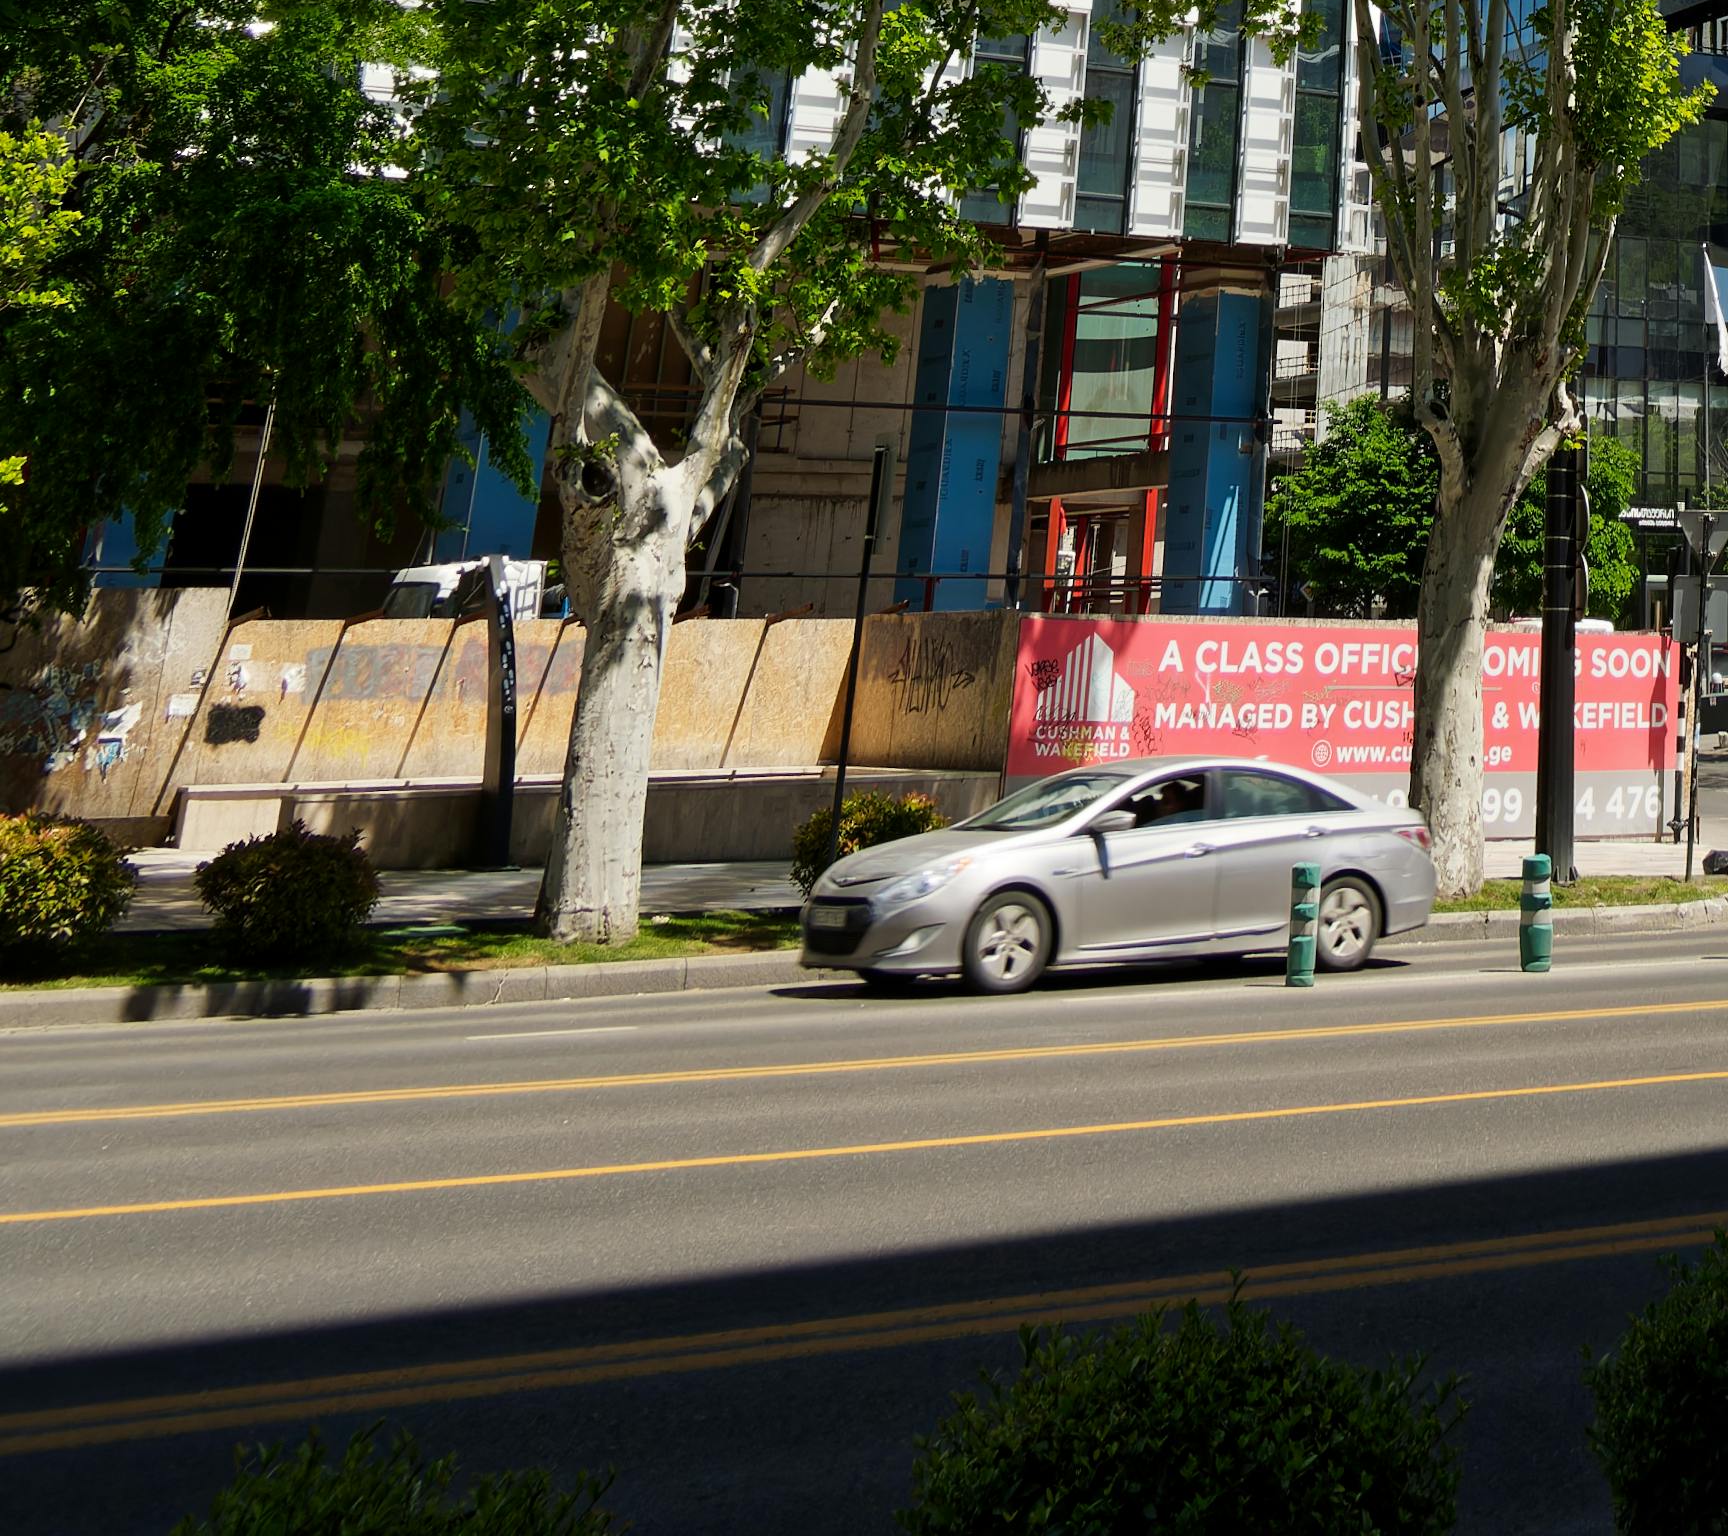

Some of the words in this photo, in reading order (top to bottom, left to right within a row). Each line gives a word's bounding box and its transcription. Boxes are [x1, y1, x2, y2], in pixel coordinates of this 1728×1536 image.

[1158, 640, 1184, 672] A
[1195, 640, 1303, 673] CLASS
[1315, 642, 1418, 675] OFFIC
[1591, 648, 1671, 678] SOON
[1154, 703, 1292, 729] MANAGED
[1301, 703, 1336, 729] BY
[1343, 700, 1415, 729] CUSH
[1492, 702, 1509, 729] &
[1518, 702, 1668, 729] WKEFIELD
[1036, 726, 1116, 740] CUSHMAN
[1120, 726, 1130, 740] &
[1035, 742, 1130, 757] WAKEFIELD
[1605, 785, 1661, 820] 476
